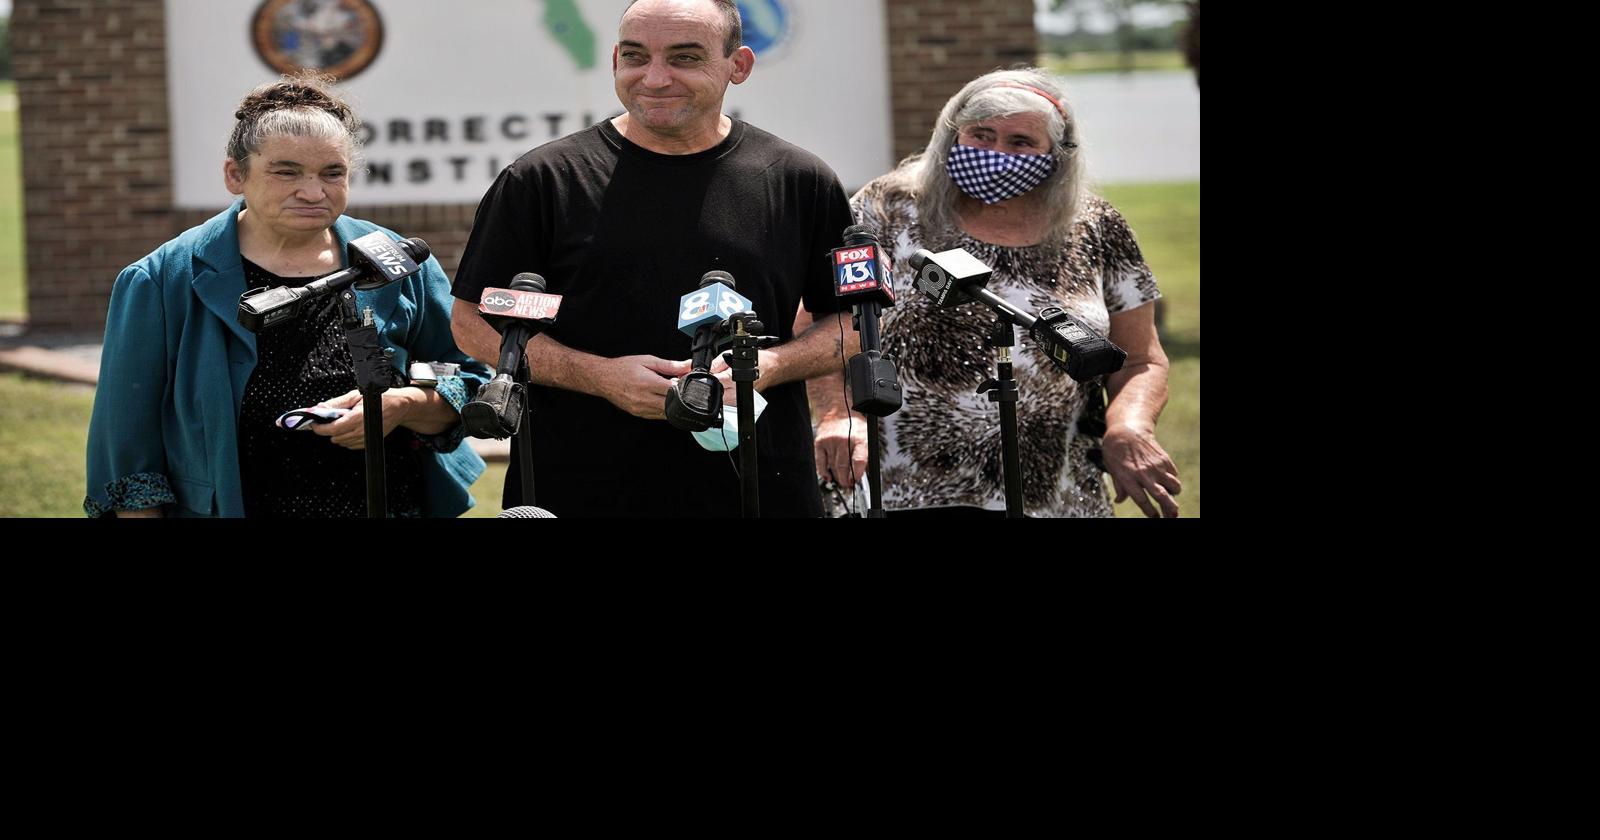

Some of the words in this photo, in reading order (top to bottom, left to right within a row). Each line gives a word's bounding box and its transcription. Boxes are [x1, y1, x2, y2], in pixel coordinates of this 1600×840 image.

[354, 112, 612, 147] ORRECTI
[840, 248, 869, 261] FOX
[843, 260, 870, 284] 13
[917, 263, 946, 298] 10
[841, 282, 875, 291] NEWS
[484, 295, 516, 307] abc
[516, 292, 559, 308] ACTION
[681, 291, 715, 320] 8
[719, 291, 744, 320] 8
[514, 303, 546, 318] NEWS
